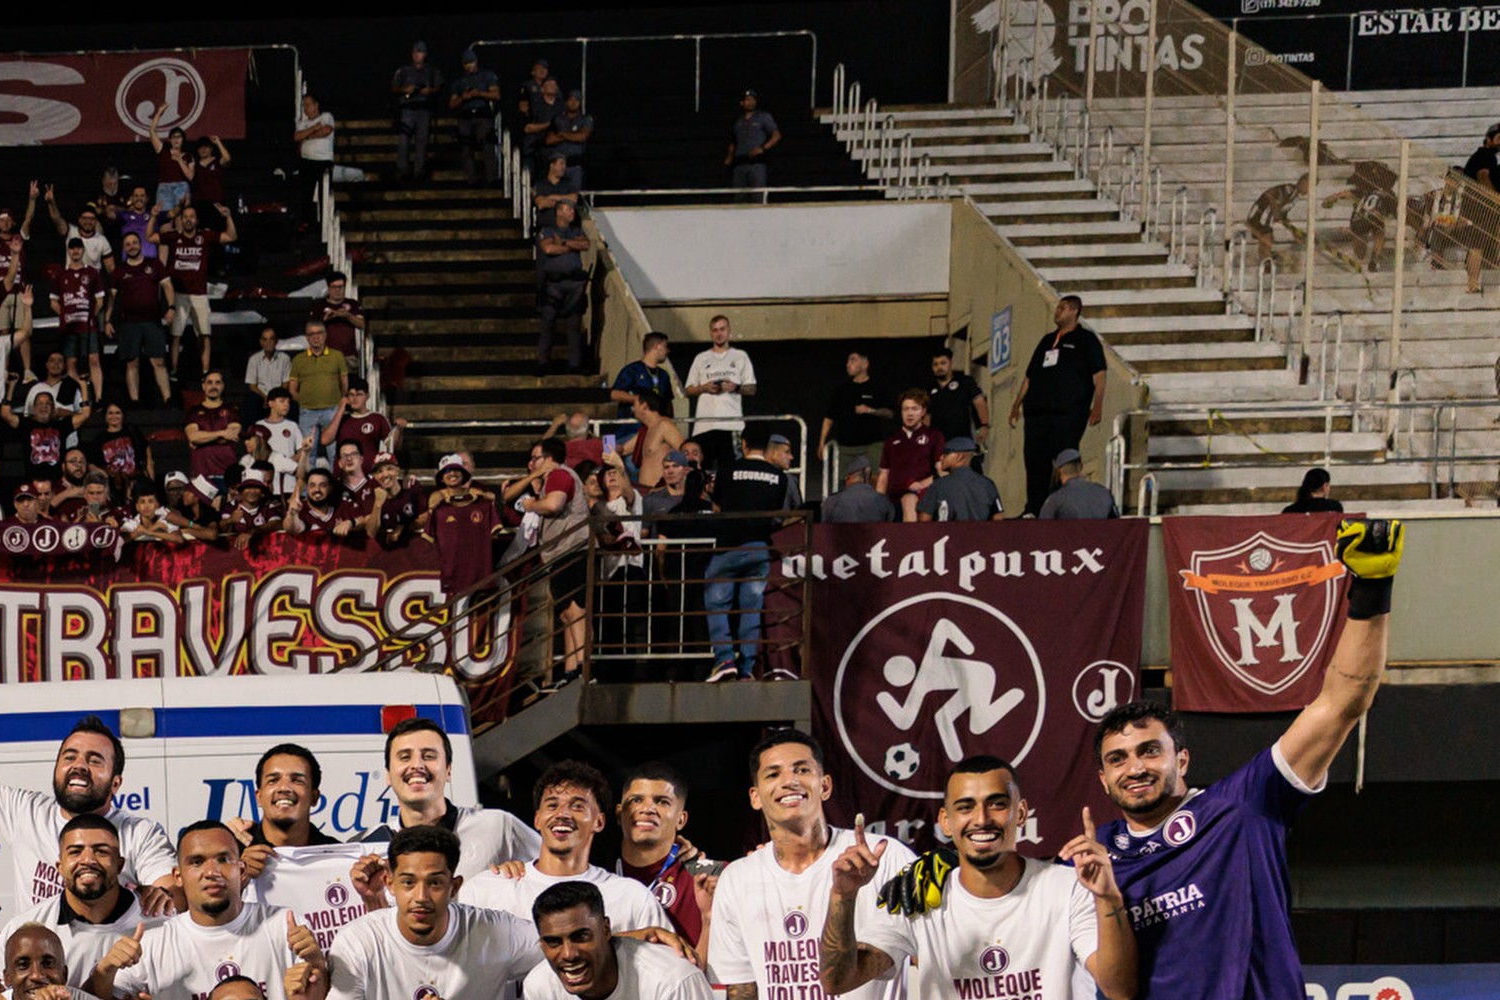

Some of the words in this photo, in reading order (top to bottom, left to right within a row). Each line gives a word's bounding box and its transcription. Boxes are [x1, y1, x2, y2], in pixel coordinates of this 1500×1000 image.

[1357, 10, 1453, 37] ESTAR
[1068, 35, 1205, 72] TINTAS
[992, 325, 1010, 366] 03
[781, 535, 1106, 592] metalpunx
[1229, 592, 1305, 666] M
[1129, 882, 1204, 923] PÁTRIA
[953, 967, 1043, 1000] MOLEQUE
